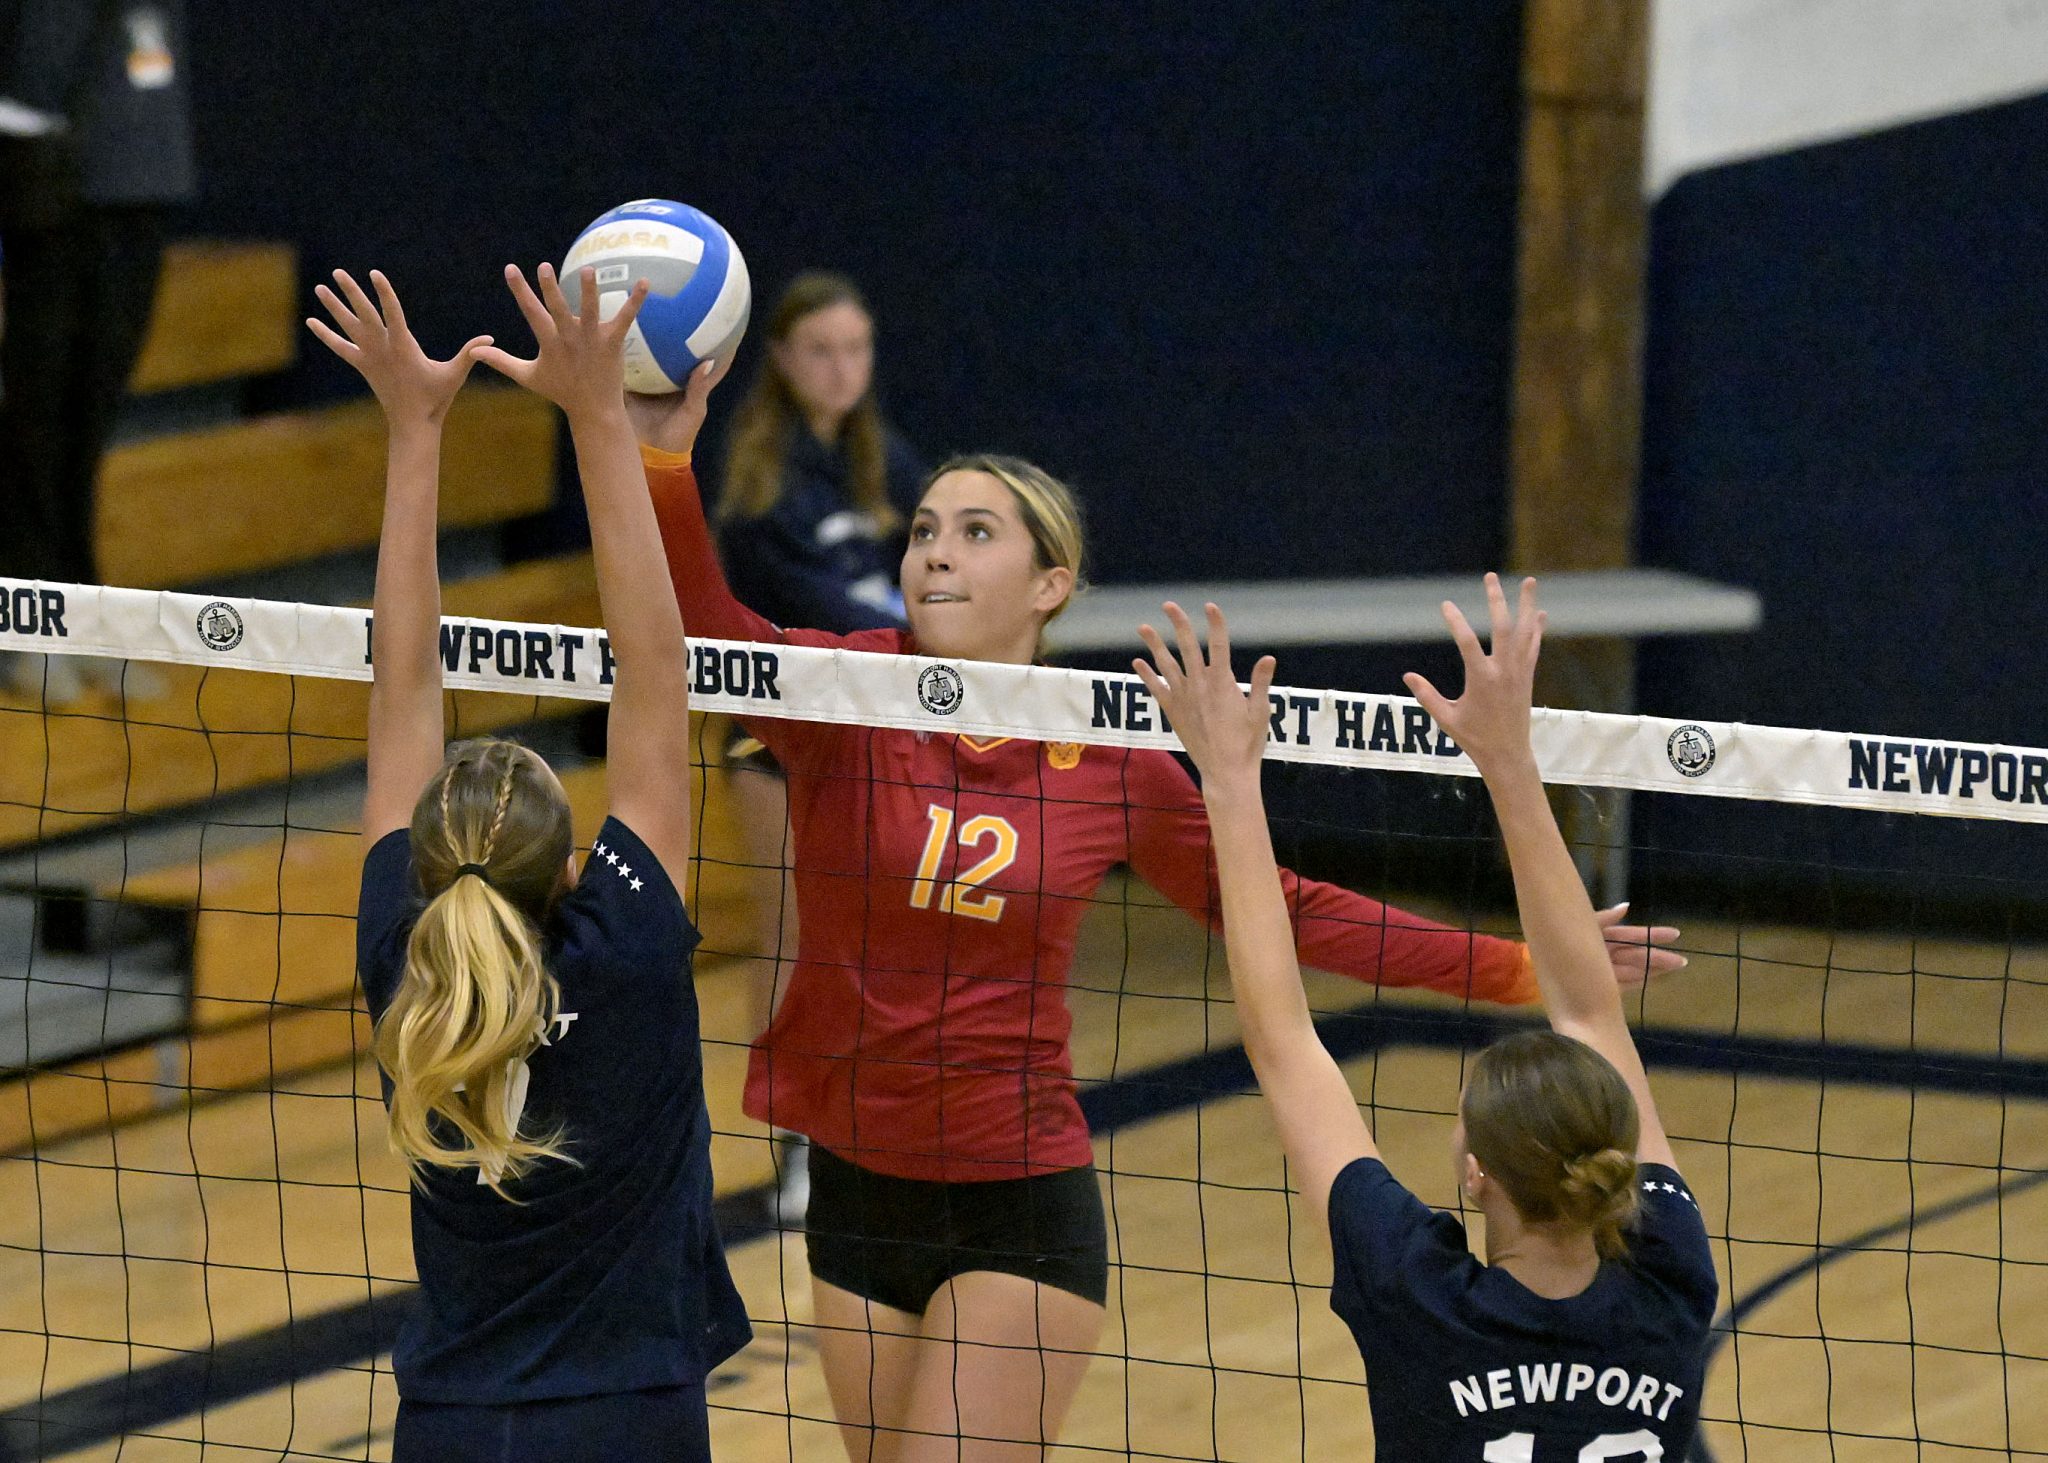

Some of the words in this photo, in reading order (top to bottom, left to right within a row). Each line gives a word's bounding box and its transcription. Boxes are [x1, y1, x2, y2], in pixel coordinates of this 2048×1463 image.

[365, 617, 583, 682] WPORT
[599, 637, 780, 700] HBOR
[1091, 679, 1320, 745] NERT
[1335, 699, 1464, 757] HARB
[909, 803, 1018, 922] 12
[1449, 1362, 1684, 1422] NEWPORT
